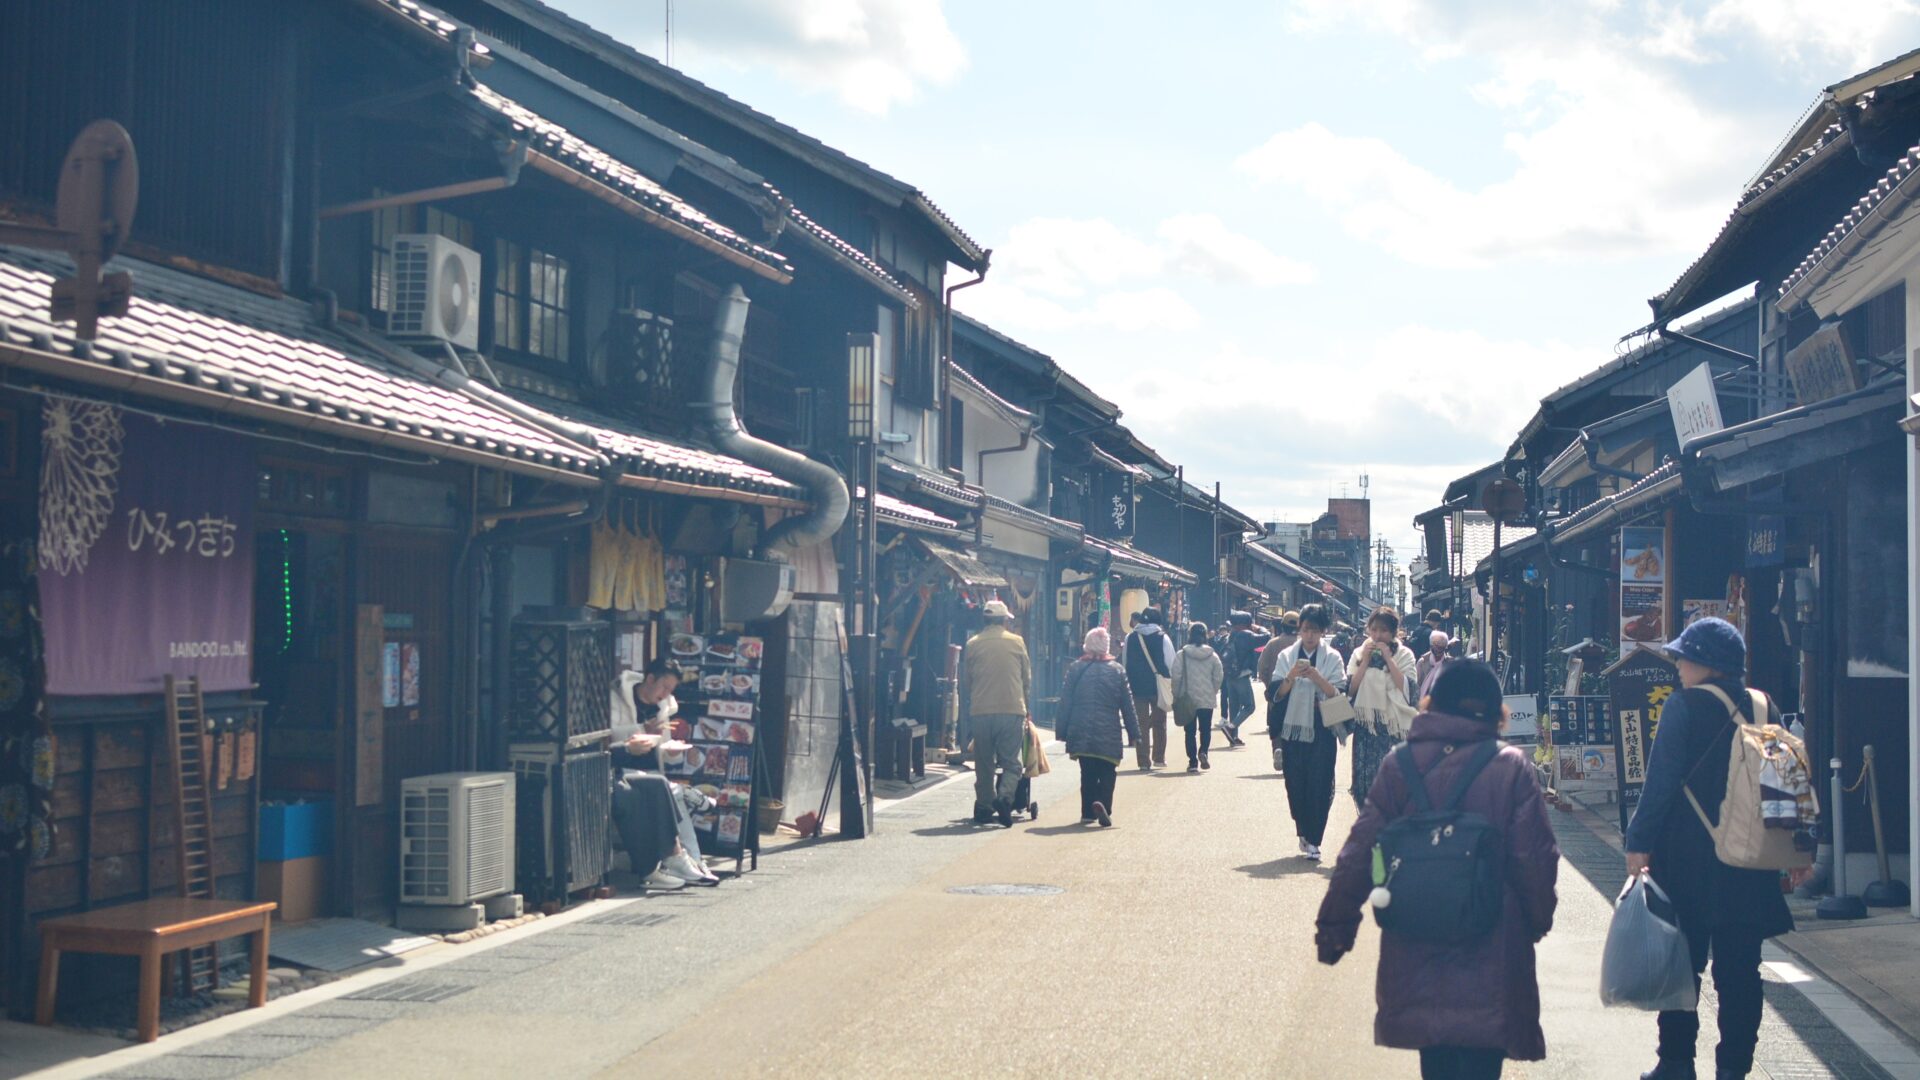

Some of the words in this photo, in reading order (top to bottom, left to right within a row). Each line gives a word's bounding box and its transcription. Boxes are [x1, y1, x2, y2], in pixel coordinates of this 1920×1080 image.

[128, 508, 237, 557] ひみつきち
[1625, 711, 1642, 779] 犬山特産品館
